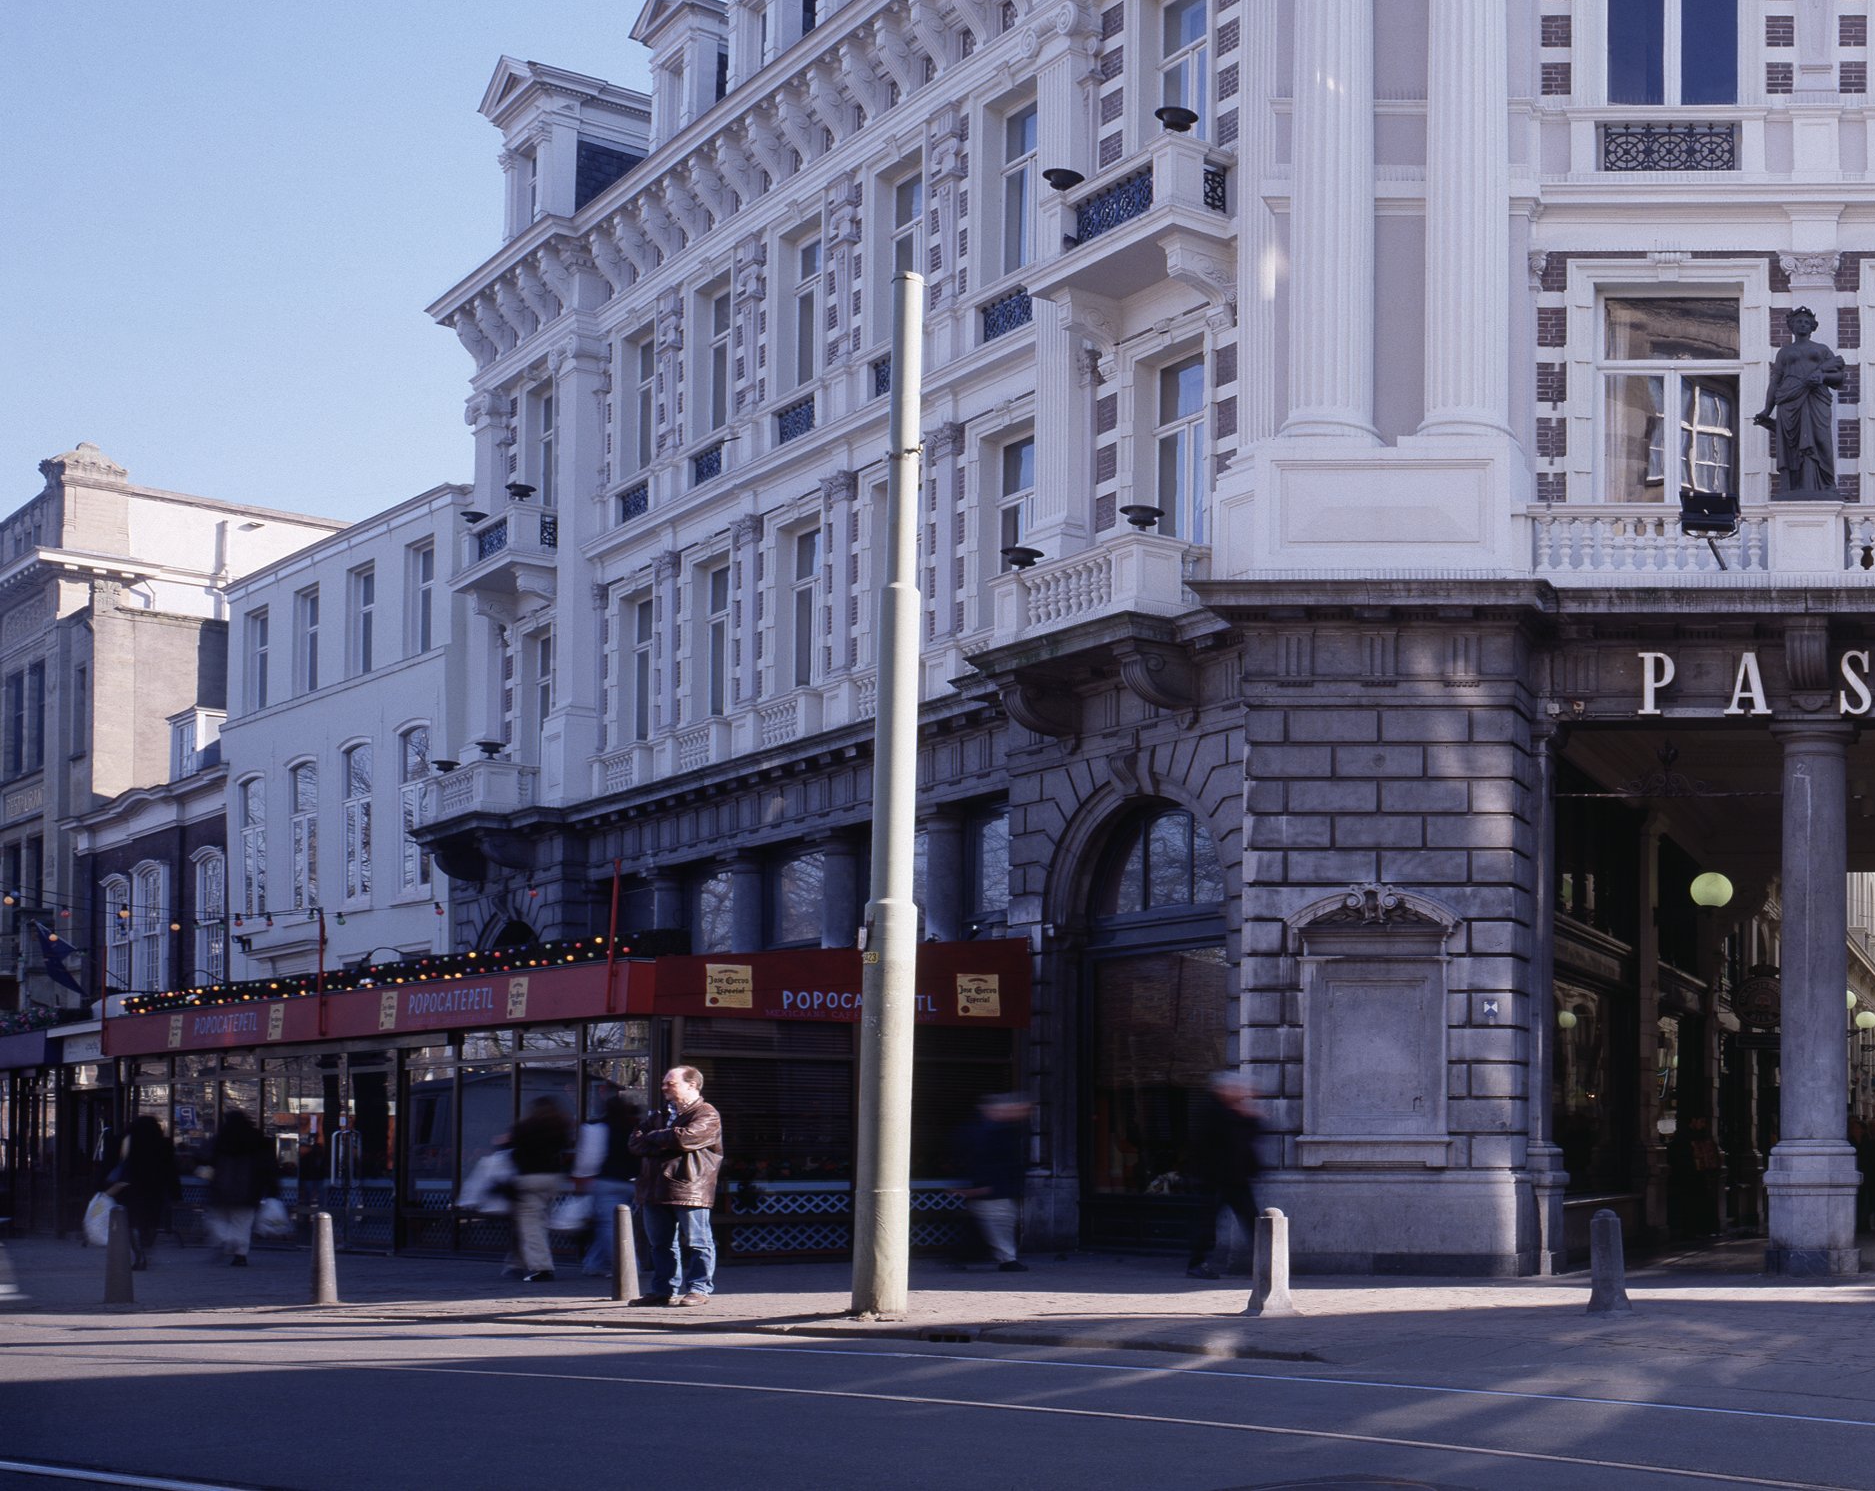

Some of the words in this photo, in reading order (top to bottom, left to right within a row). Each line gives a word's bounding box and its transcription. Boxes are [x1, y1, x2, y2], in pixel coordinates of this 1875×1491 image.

[717, 986, 745, 995] Especial
[408, 987, 494, 1015] POPOCATEPETL
[965, 995, 990, 1004] Especial
[194, 1011, 257, 1035] POPOCATEPETL
